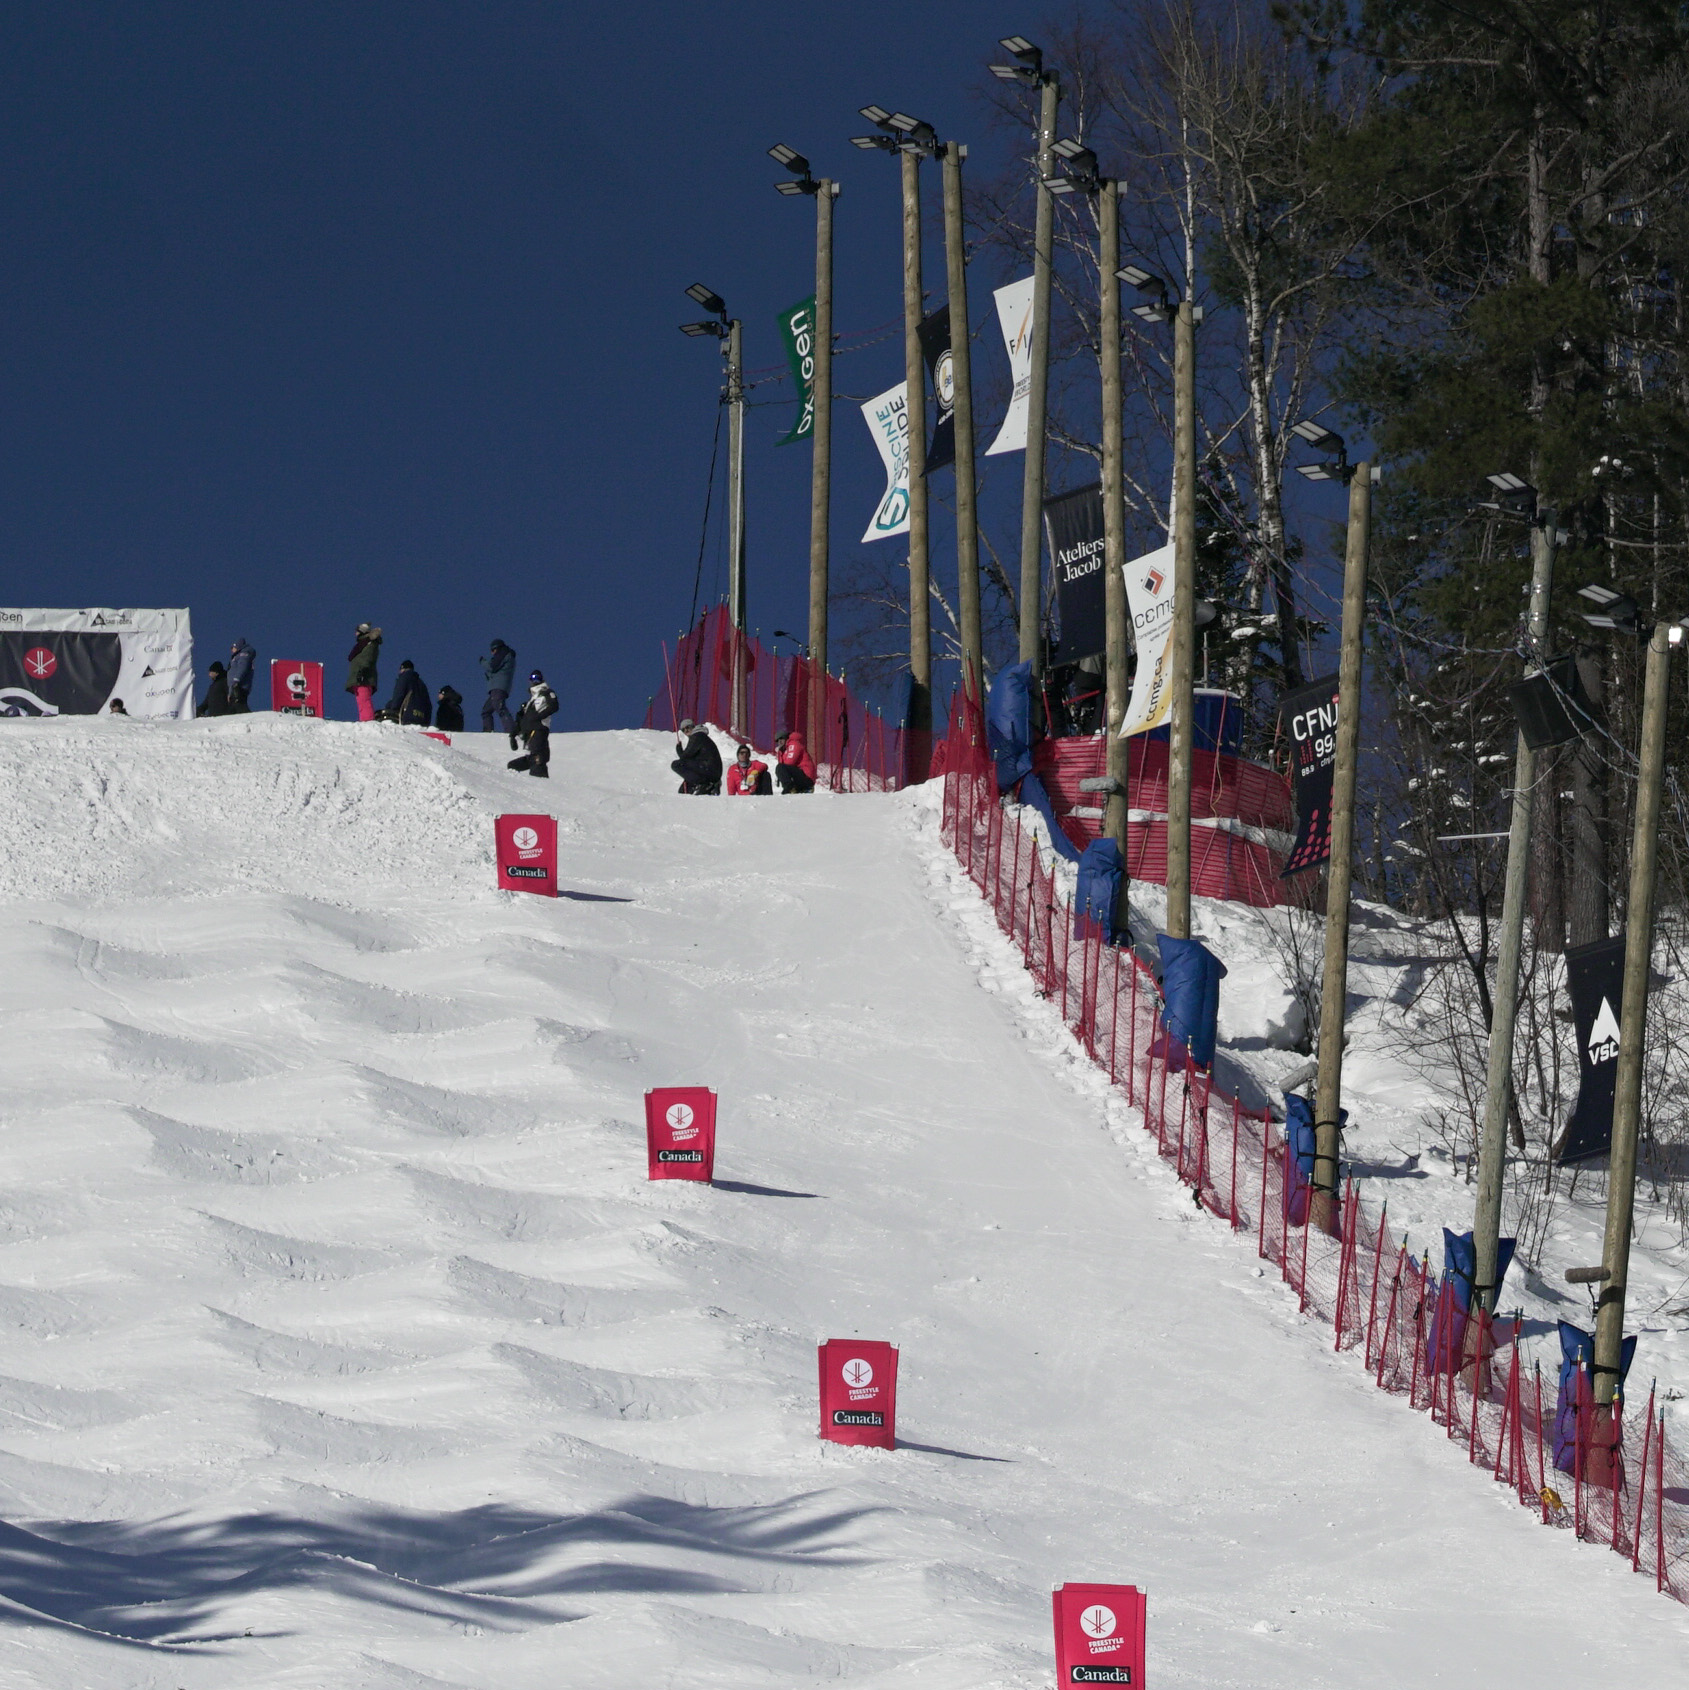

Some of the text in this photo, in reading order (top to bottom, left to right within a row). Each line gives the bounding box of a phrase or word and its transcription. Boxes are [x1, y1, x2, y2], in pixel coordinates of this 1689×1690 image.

[1056, 537, 1104, 567] Ateliers
[1063, 555, 1102, 582] Jacob
[1146, 656, 1163, 723] ccmg.ca
[1301, 763, 1315, 777] 88.9
[508, 866, 547, 878] Canada
[658, 1150, 702, 1162] Canada
[834, 1411, 883, 1425] Canada
[1088, 1637, 1125, 1648] FREESTYLE
[1090, 1645, 1117, 1655] CANADA
[1072, 1666, 1130, 1682] Canada
